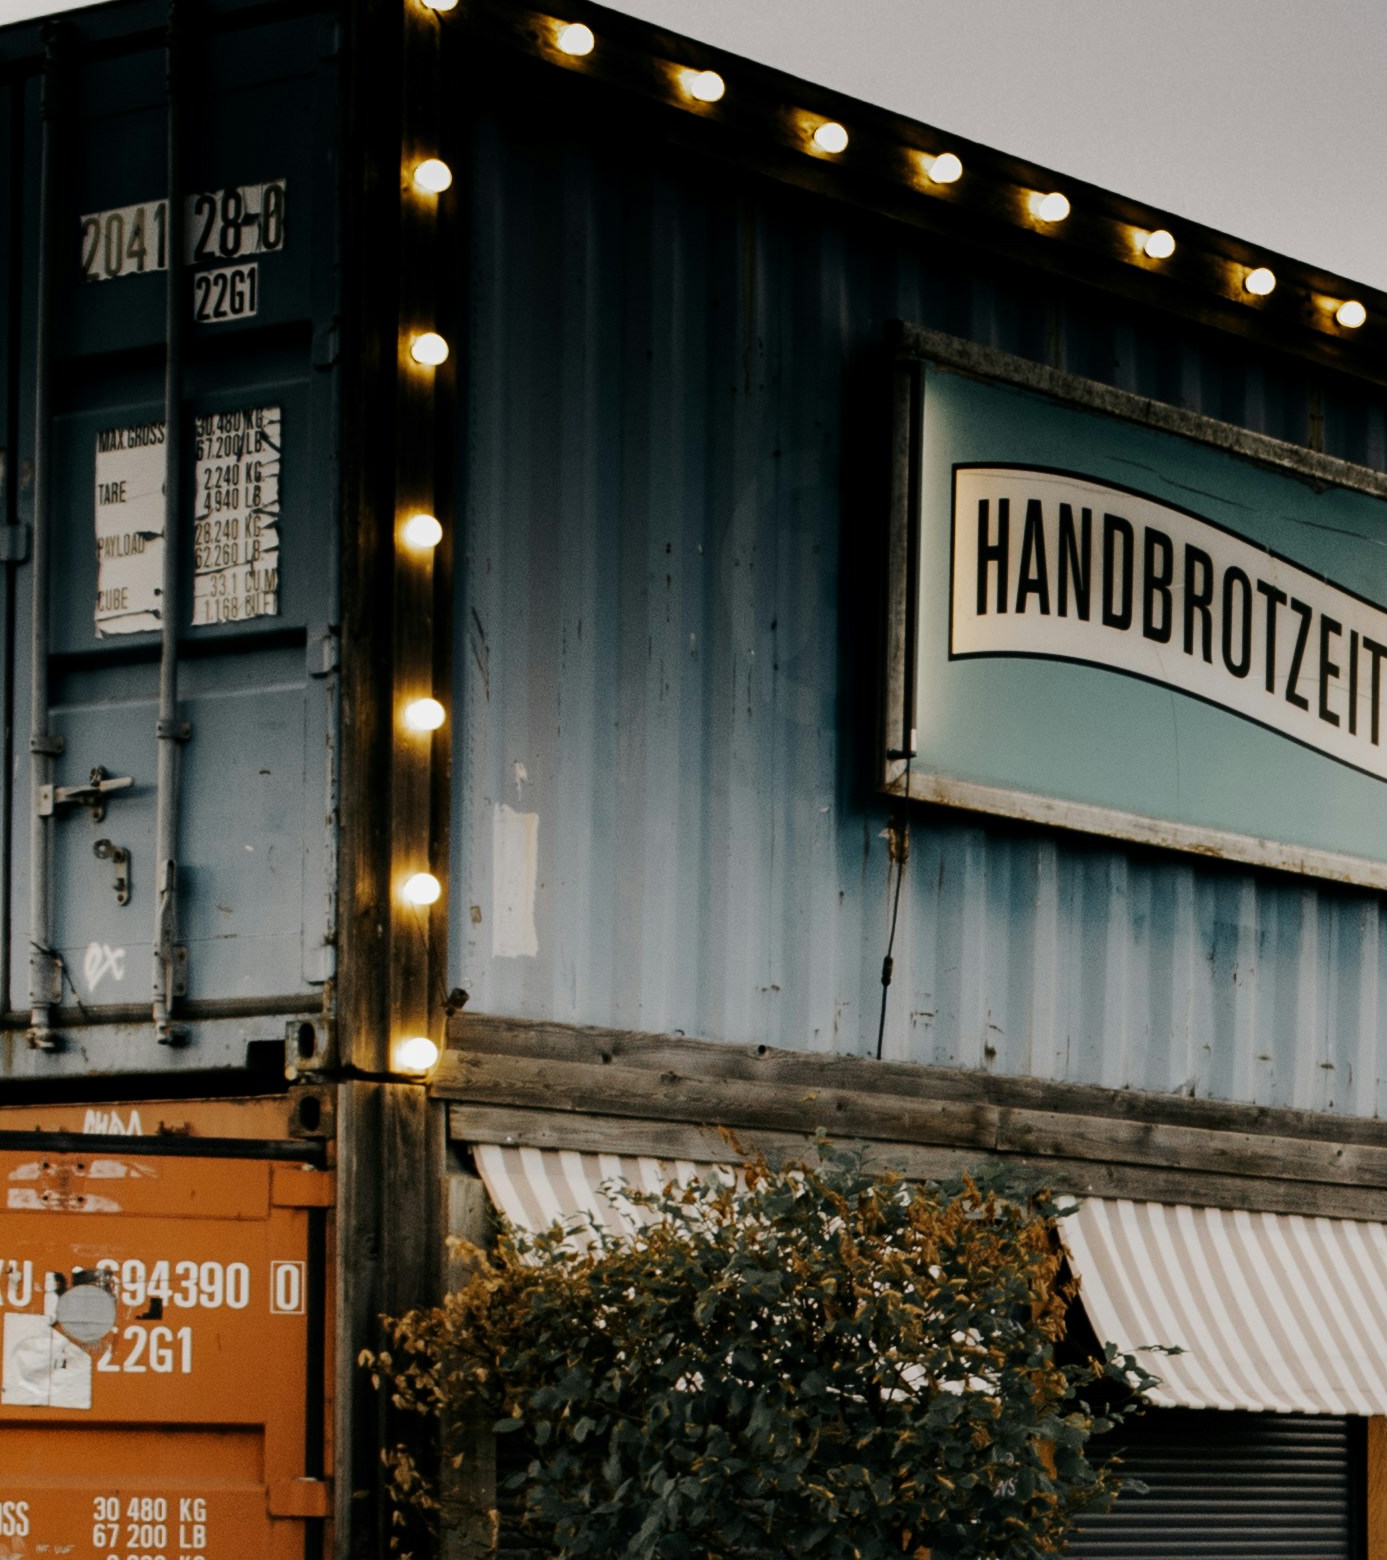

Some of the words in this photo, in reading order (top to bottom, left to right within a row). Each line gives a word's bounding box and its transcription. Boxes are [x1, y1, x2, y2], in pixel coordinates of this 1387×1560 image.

[196, 268, 256, 321] 22G1
[127, 424, 166, 448] GROSS
[204, 464, 240, 490] 2.240
[99, 481, 126, 505] TARE
[204, 489, 240, 513] 4.940
[97, 533, 145, 560] PAYLOAD
[98, 587, 128, 611] CUBE
[275, 1263, 301, 1311] 0
[0, 1501, 29, 1537] SS
[93, 1497, 120, 1522] 30
[126, 1497, 168, 1522] 480
[180, 1497, 207, 1522] KG
[93, 1524, 120, 1548] 67
[126, 1524, 168, 1549] 200
[180, 1524, 207, 1549] LB
